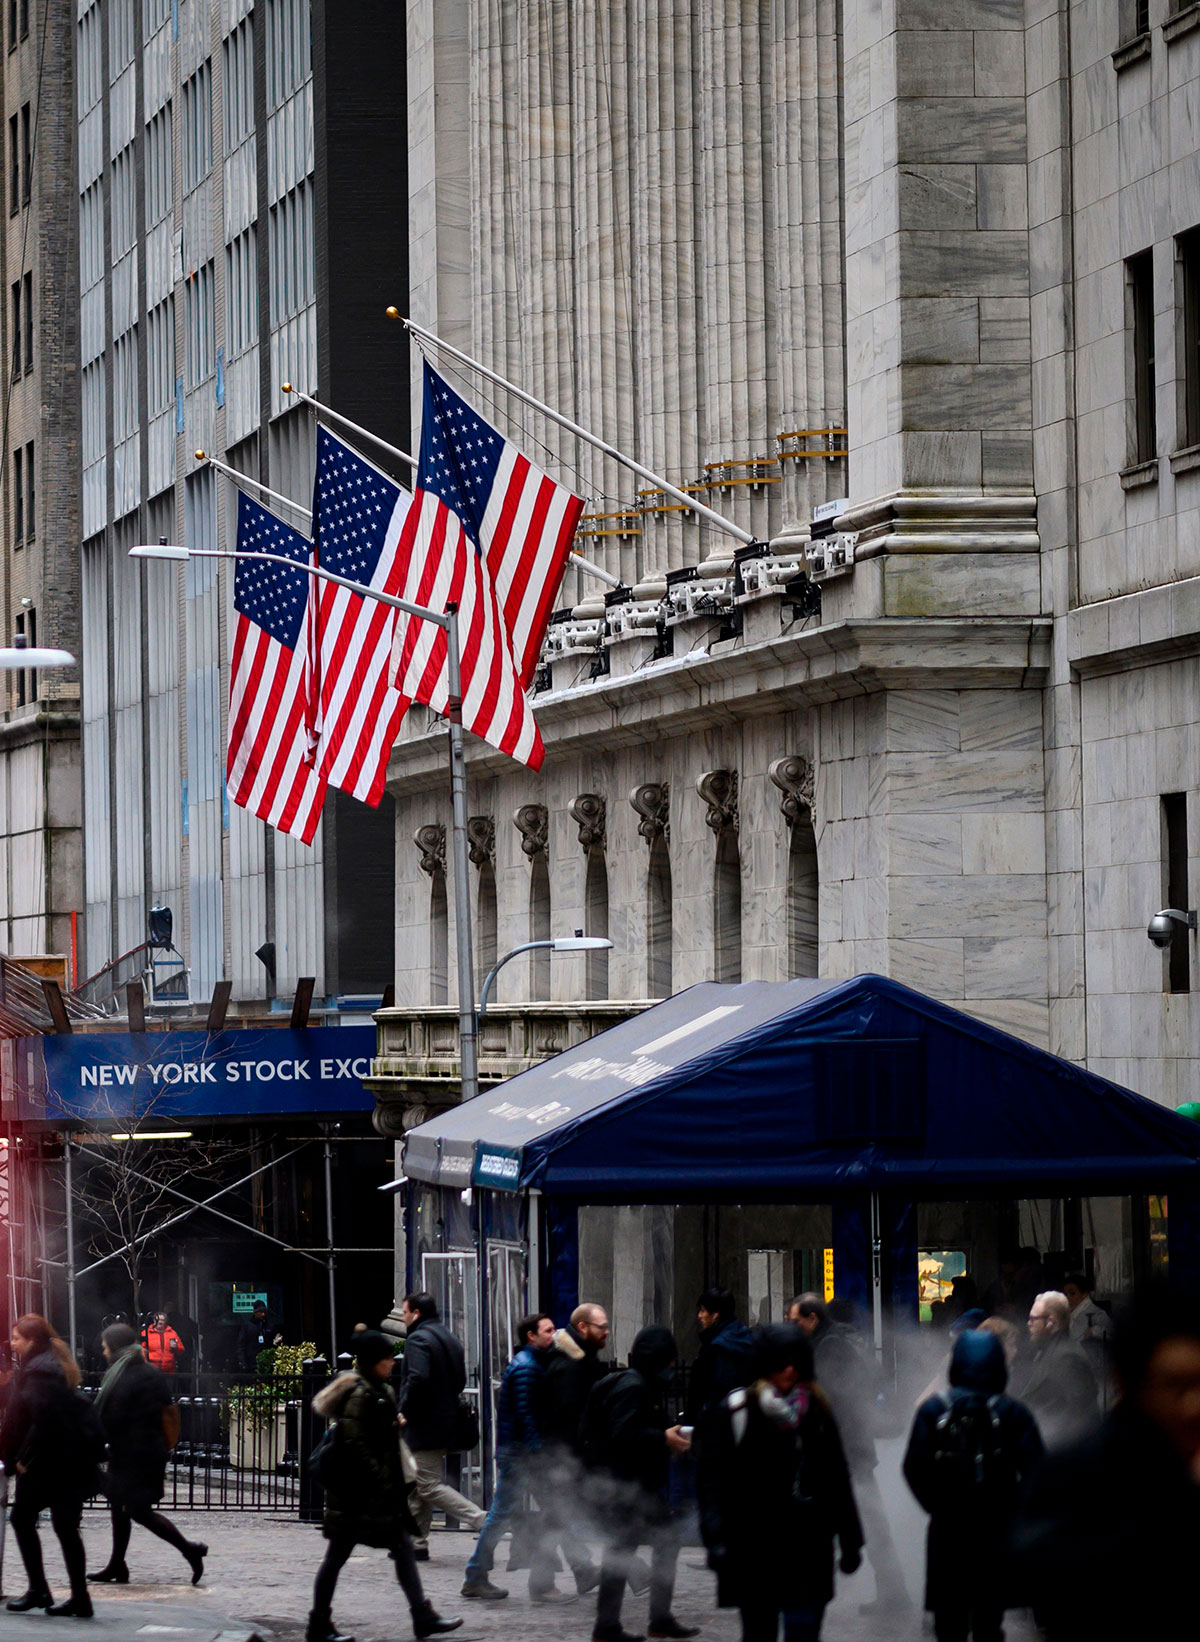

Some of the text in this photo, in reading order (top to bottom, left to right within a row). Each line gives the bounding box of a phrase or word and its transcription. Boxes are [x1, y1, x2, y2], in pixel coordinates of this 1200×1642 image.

[80, 1064, 139, 1087] NEW
[147, 1062, 217, 1086] YORK
[225, 1059, 312, 1082] STOCK
